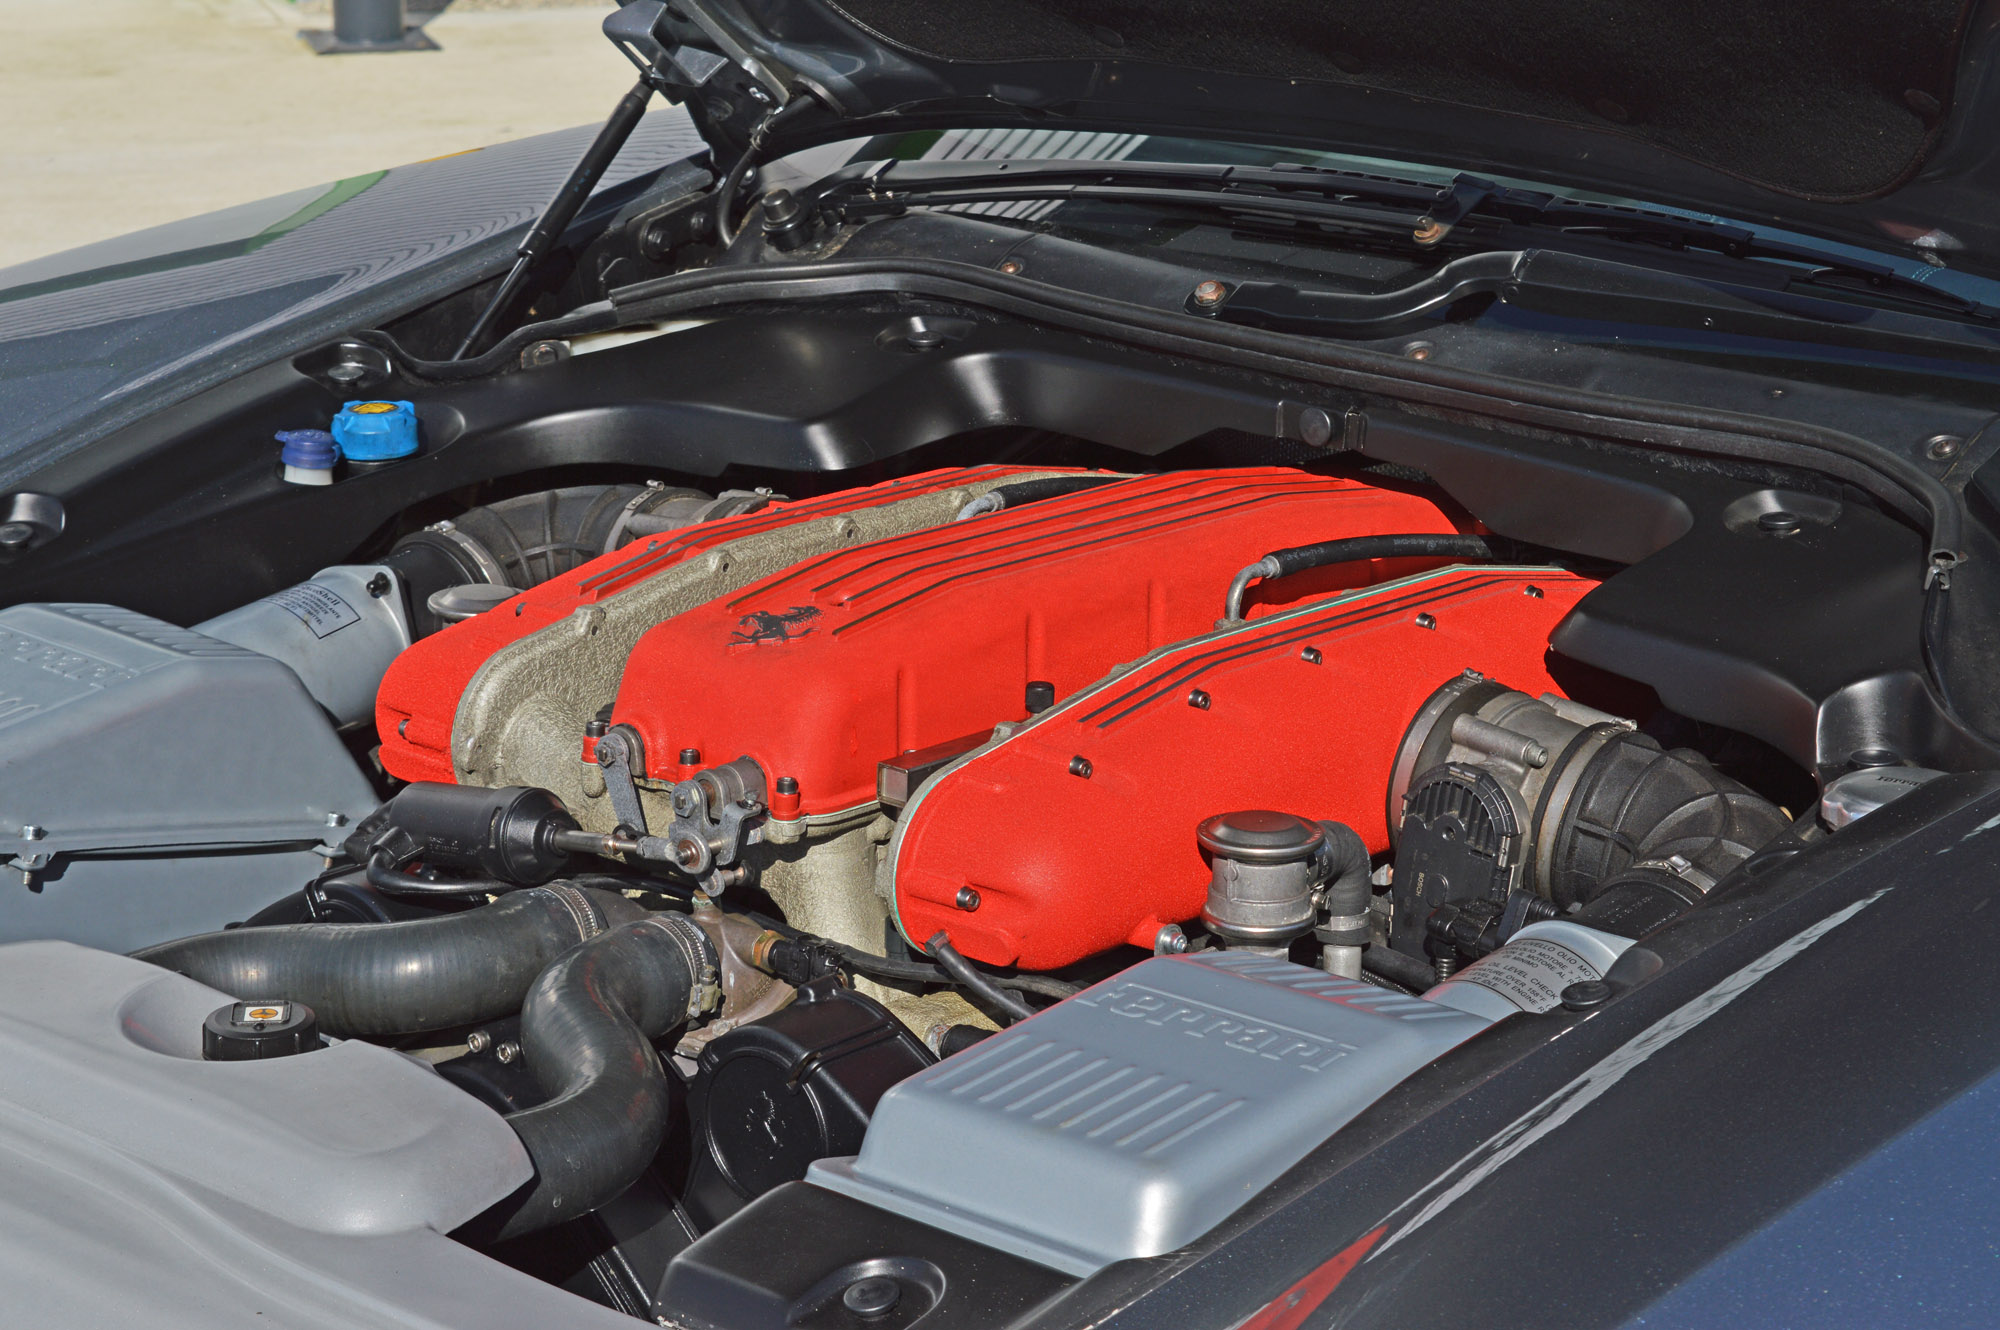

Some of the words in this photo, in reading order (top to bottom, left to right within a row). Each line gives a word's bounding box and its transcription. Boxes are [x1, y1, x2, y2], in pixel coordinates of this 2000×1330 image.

[1415, 871, 1425, 897] BOSCH
[1512, 956, 1539, 969] MINIMO
[1522, 941, 1556, 952] LIVELLO
[1556, 951, 1578, 965] OLIO
[1538, 951, 1568, 970] MOTORE
[1527, 954, 1556, 972] MOTORE
[1556, 971, 1566, 980] AL
[1481, 979, 1500, 988] IDLE
[1491, 975, 1510, 987] WITH
[1511, 986, 1539, 1006] ENGINE
[1503, 965, 1528, 979] LEVEL
[1530, 978, 1559, 1000] CHECK
[1505, 974, 1527, 988] OVER
[1074, 983, 1359, 1072] Ferrari
